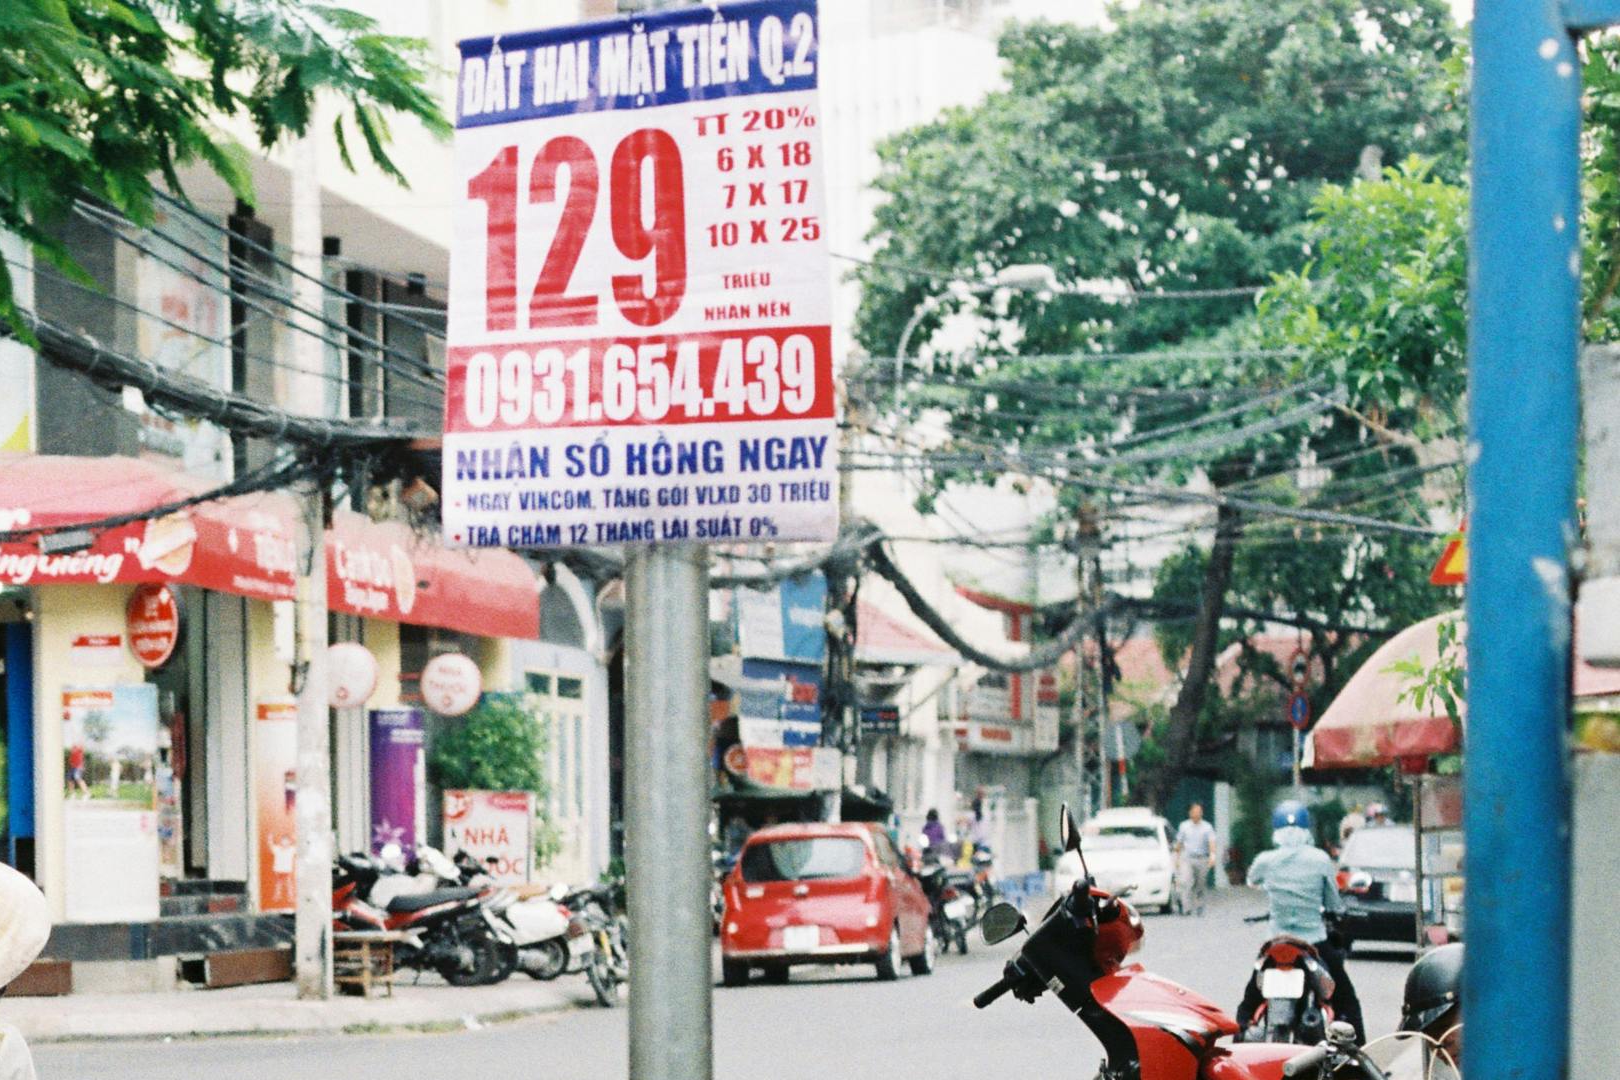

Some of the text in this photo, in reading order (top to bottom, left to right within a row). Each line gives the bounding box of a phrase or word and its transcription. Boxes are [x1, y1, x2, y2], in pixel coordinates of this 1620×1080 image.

[461, 34, 527, 117] ĐẤT
[533, 40, 590, 107] HAI
[598, 22, 670, 106] MẶT
[758, 12, 814, 86] Q.2
[693, 105, 816, 137] TT 20%
[717, 140, 812, 172] 6 X 18
[722, 179, 809, 209] 7 X 17
[467, 128, 687, 331] 129
[706, 216, 821, 248] 10 X 25
[465, 334, 816, 428] 0931.654.439
[456, 440, 550, 486] NHẬN
[739, 435, 828, 472] NGAY
[466, 492, 512, 511] NGAY
[695, 484, 741, 505] VLXD
[747, 482, 772, 504] 30
[568, 522, 588, 545] 12
[749, 516, 779, 538] 0%
